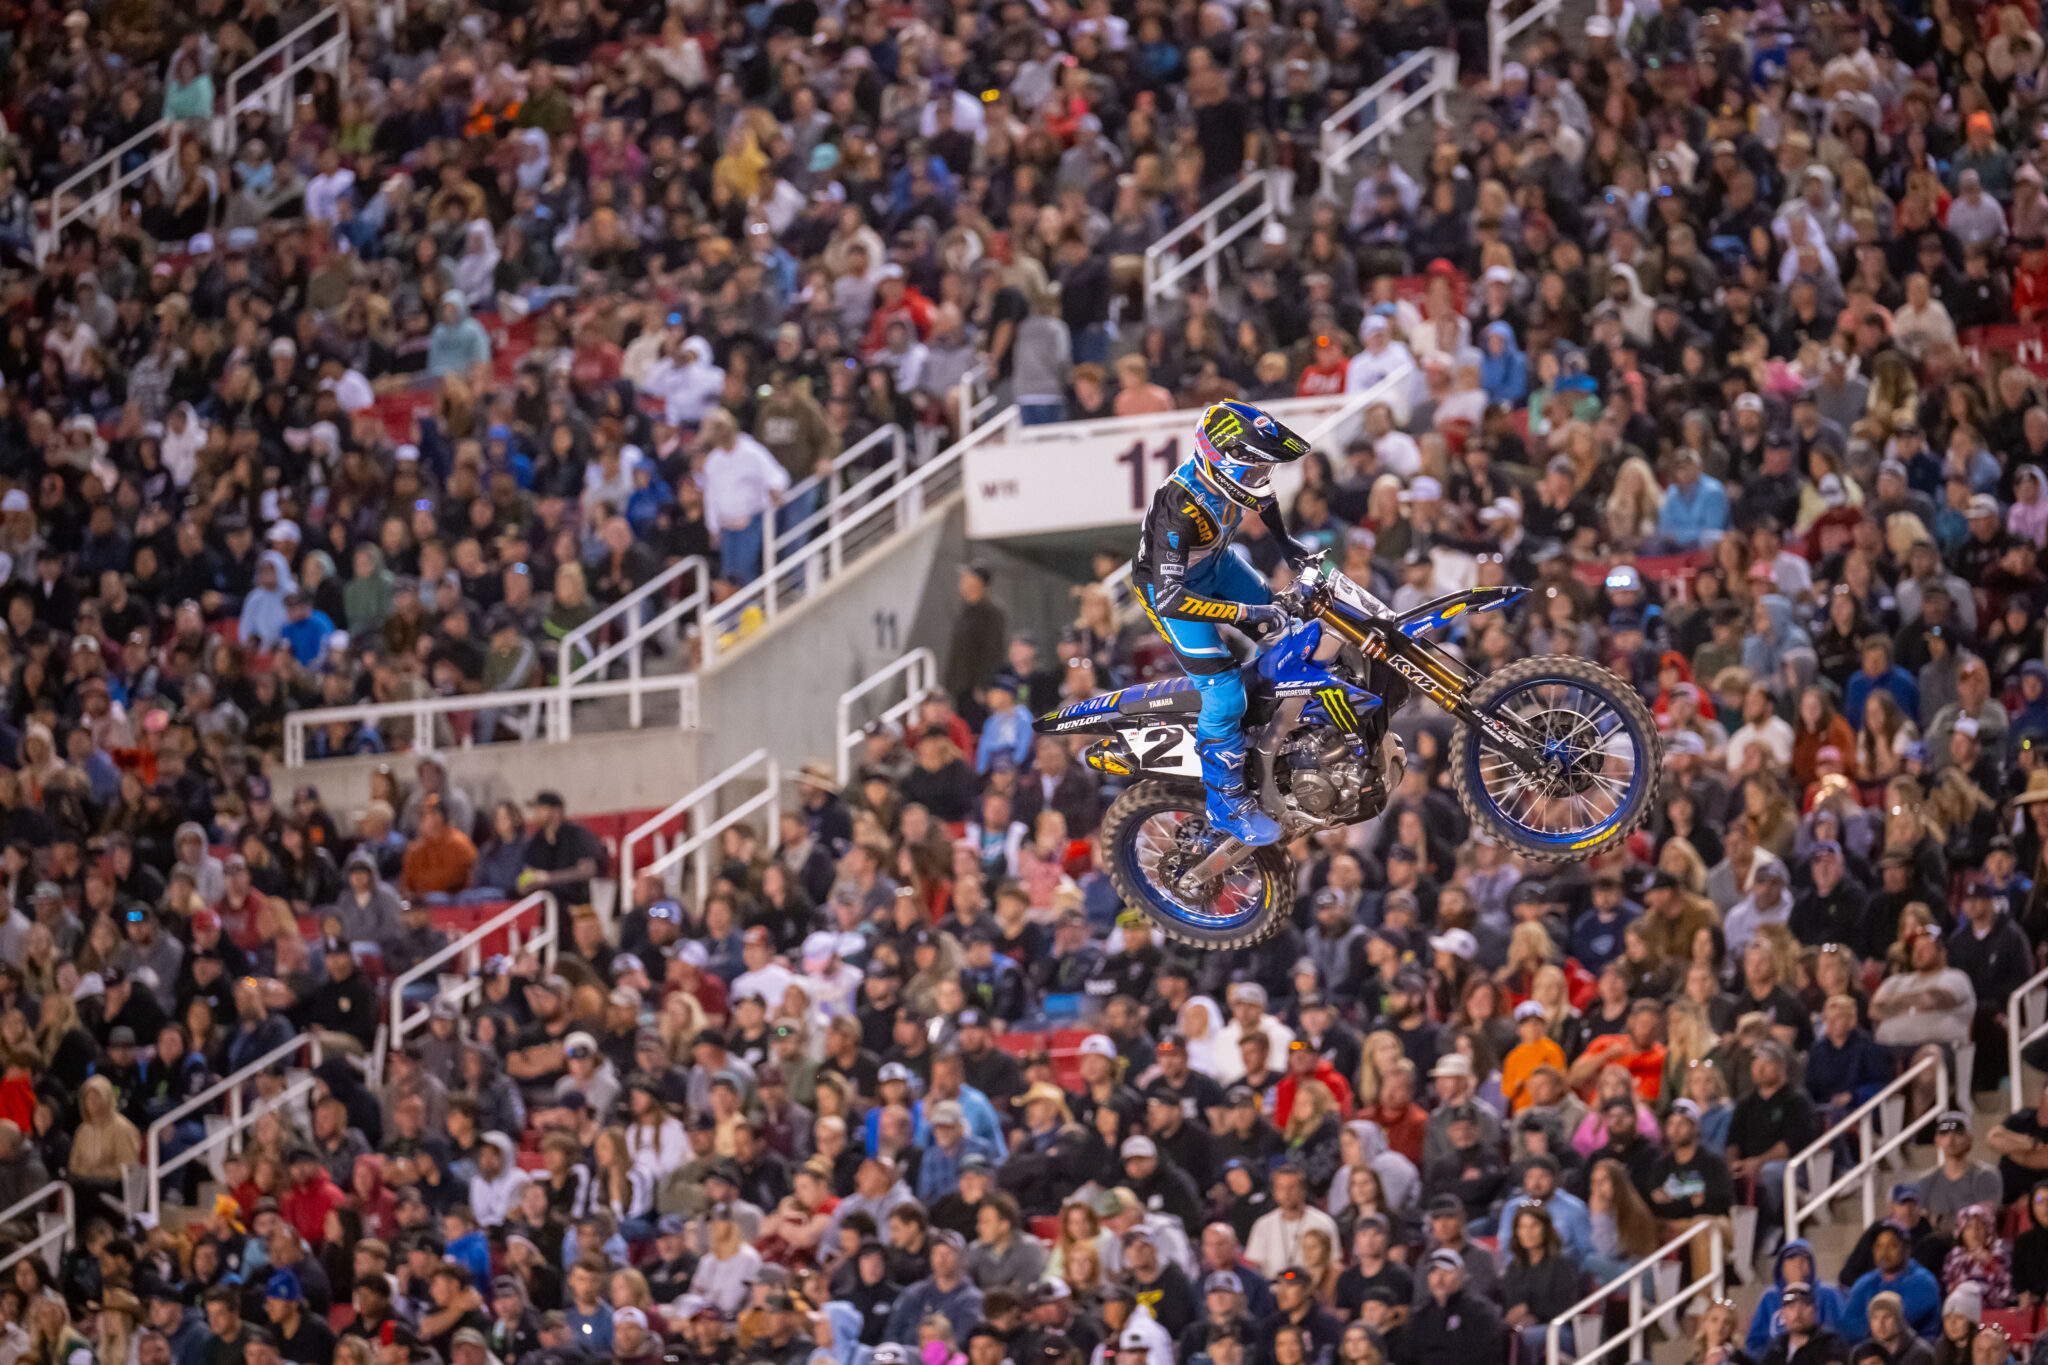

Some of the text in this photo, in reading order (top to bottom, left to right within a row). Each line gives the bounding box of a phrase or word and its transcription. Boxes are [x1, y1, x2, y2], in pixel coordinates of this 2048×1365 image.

[1196, 430, 1236, 475] 100%
[1117, 436, 1181, 510] 11
[1214, 473, 1248, 500] MONSTER
[1181, 501, 1214, 543] THOR
[1177, 596, 1239, 620] THOR
[1275, 688, 1312, 698] PROGRESSIVE
[1387, 654, 1439, 694] KYB
[1055, 715, 1102, 731] DUNLOP
[1148, 697, 1173, 709] YAMAHA
[1142, 727, 1184, 769] 2
[1471, 708, 1526, 750] DUNLOP
